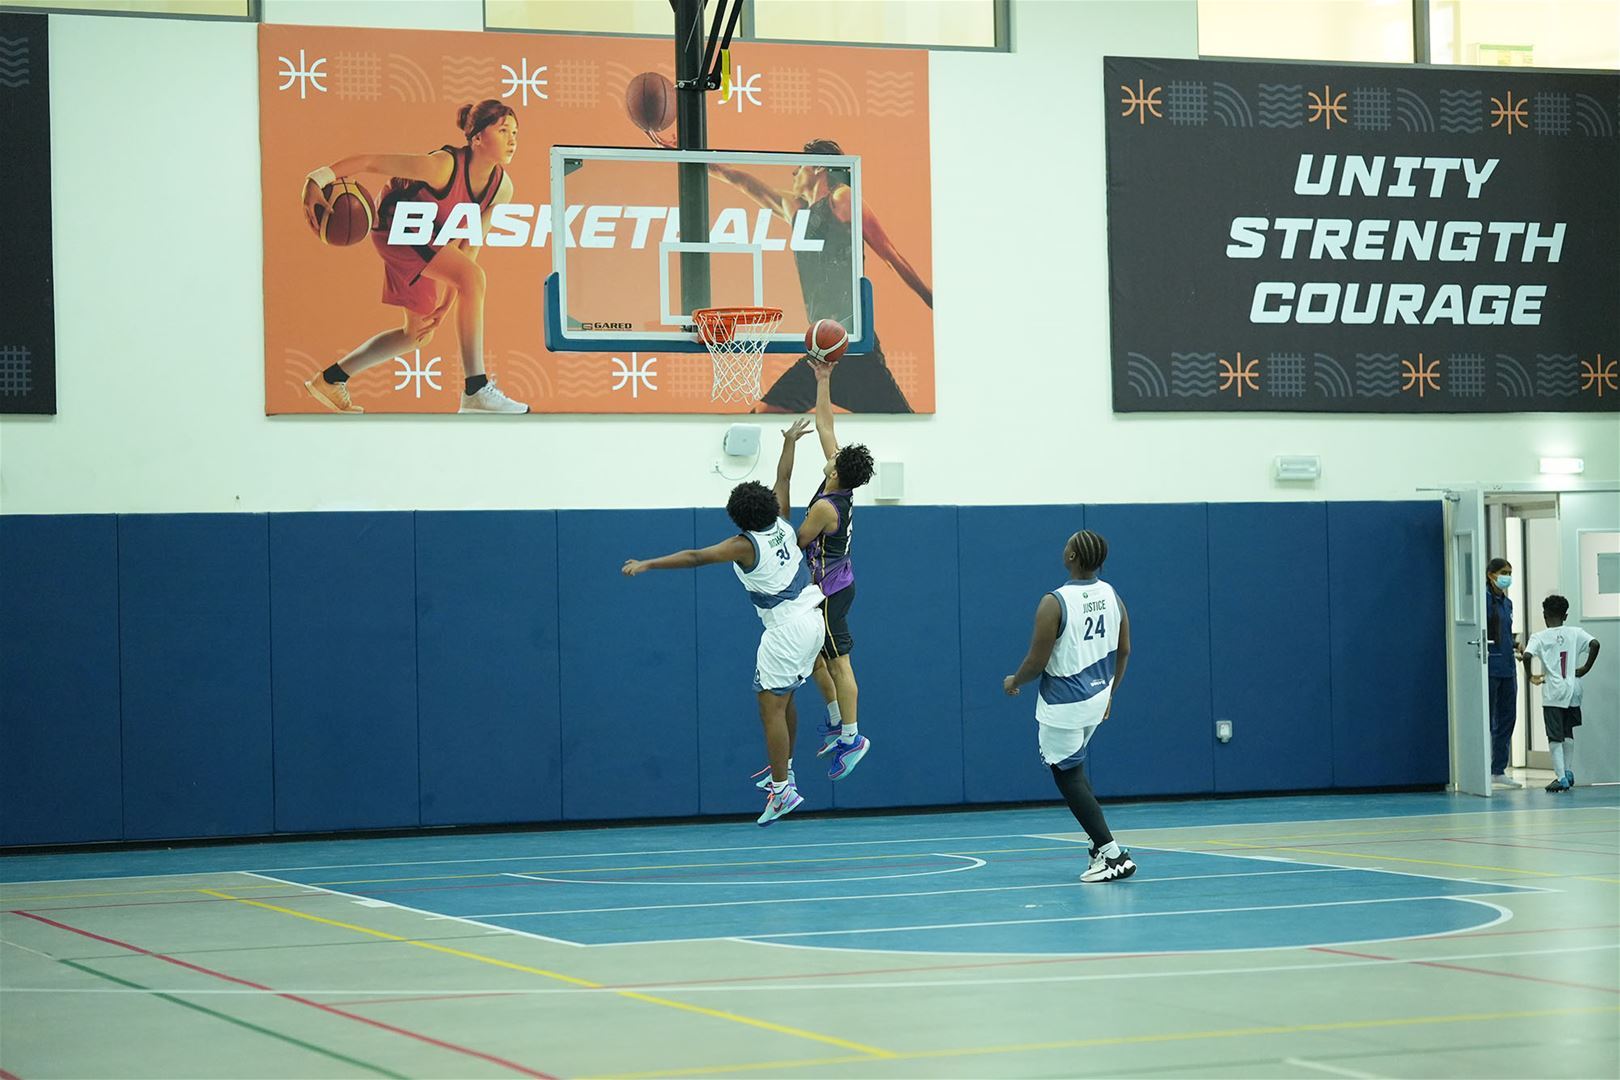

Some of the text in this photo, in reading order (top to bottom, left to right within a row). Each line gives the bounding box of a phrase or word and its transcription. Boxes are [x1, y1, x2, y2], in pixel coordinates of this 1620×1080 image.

[1294, 154, 1499, 198] UNITY
[1225, 217, 1567, 262] STRENGTH
[1250, 282, 1547, 325] COURAGE
[1083, 600, 1106, 614] JUSTICE
[1084, 614, 1106, 641] 24
[1560, 651, 1567, 679] 1
